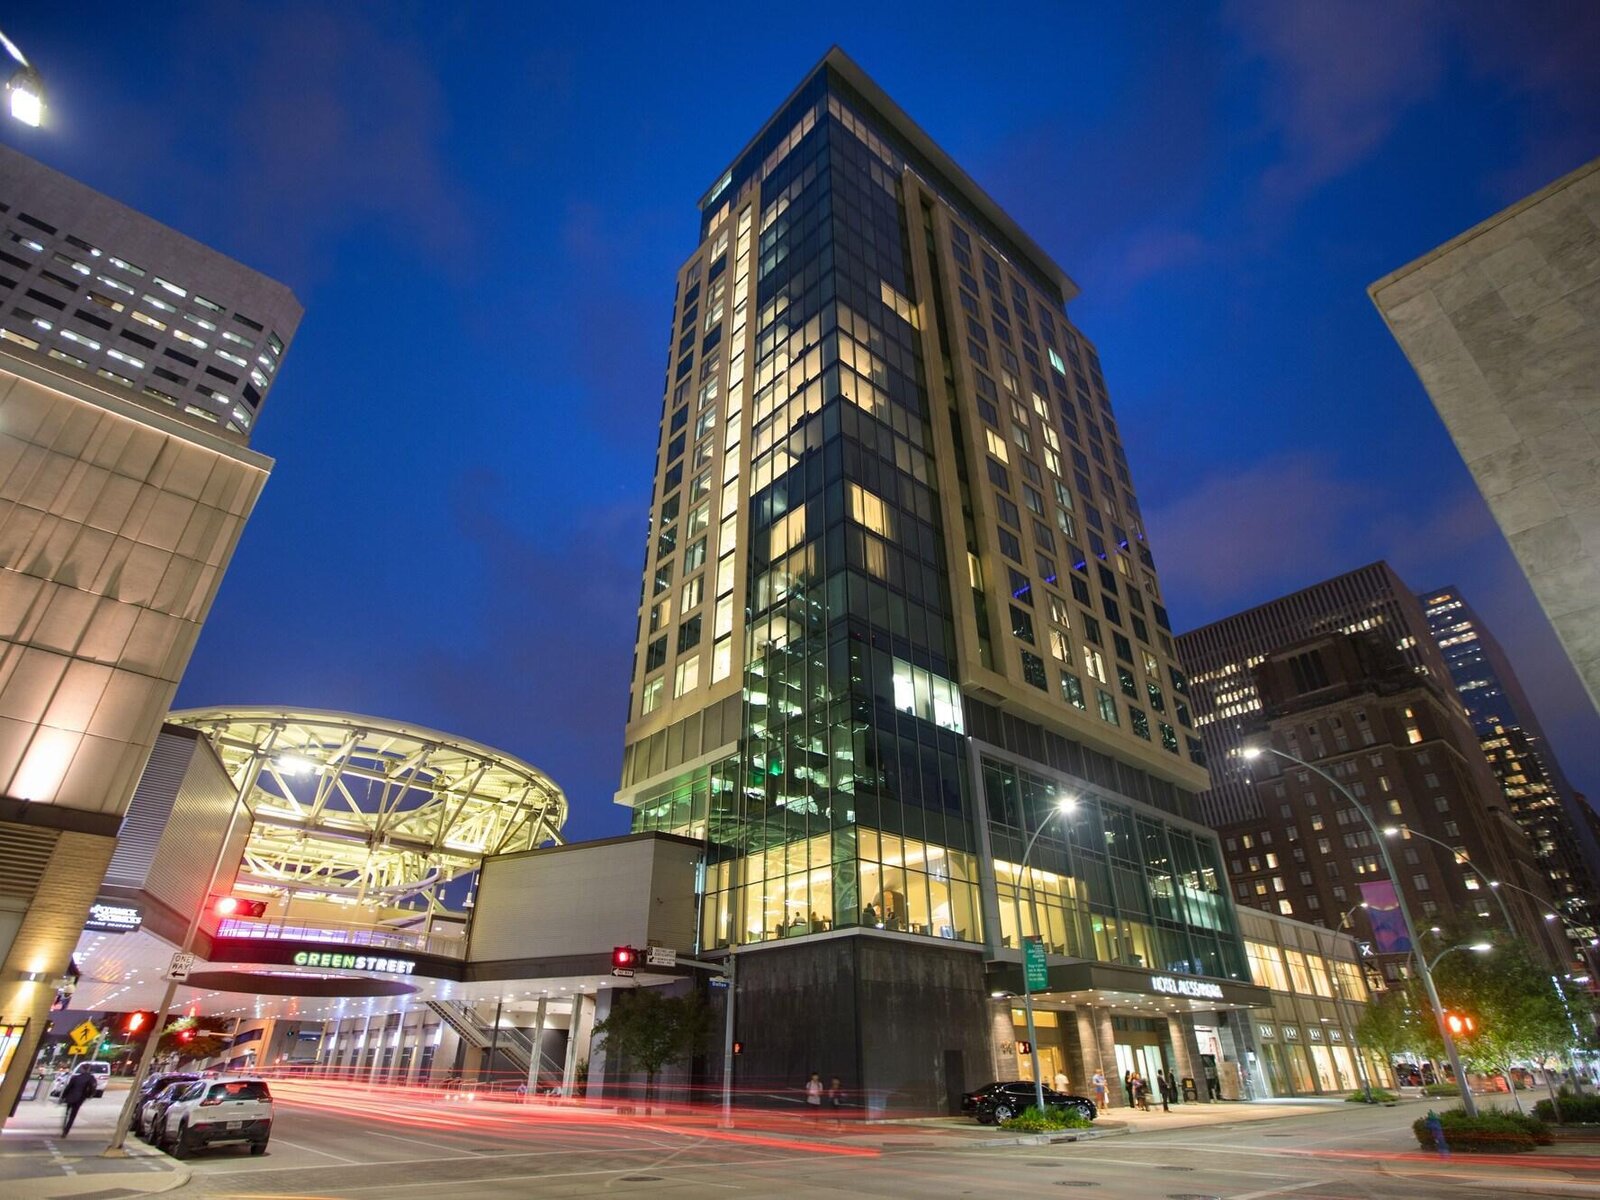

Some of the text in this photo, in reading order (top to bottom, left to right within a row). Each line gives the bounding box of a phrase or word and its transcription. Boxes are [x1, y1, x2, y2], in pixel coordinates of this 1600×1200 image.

[174, 954, 193, 964] ONE
[294, 952, 416, 974] GREENSTREET
[1151, 976, 1179, 994] HOTEL
